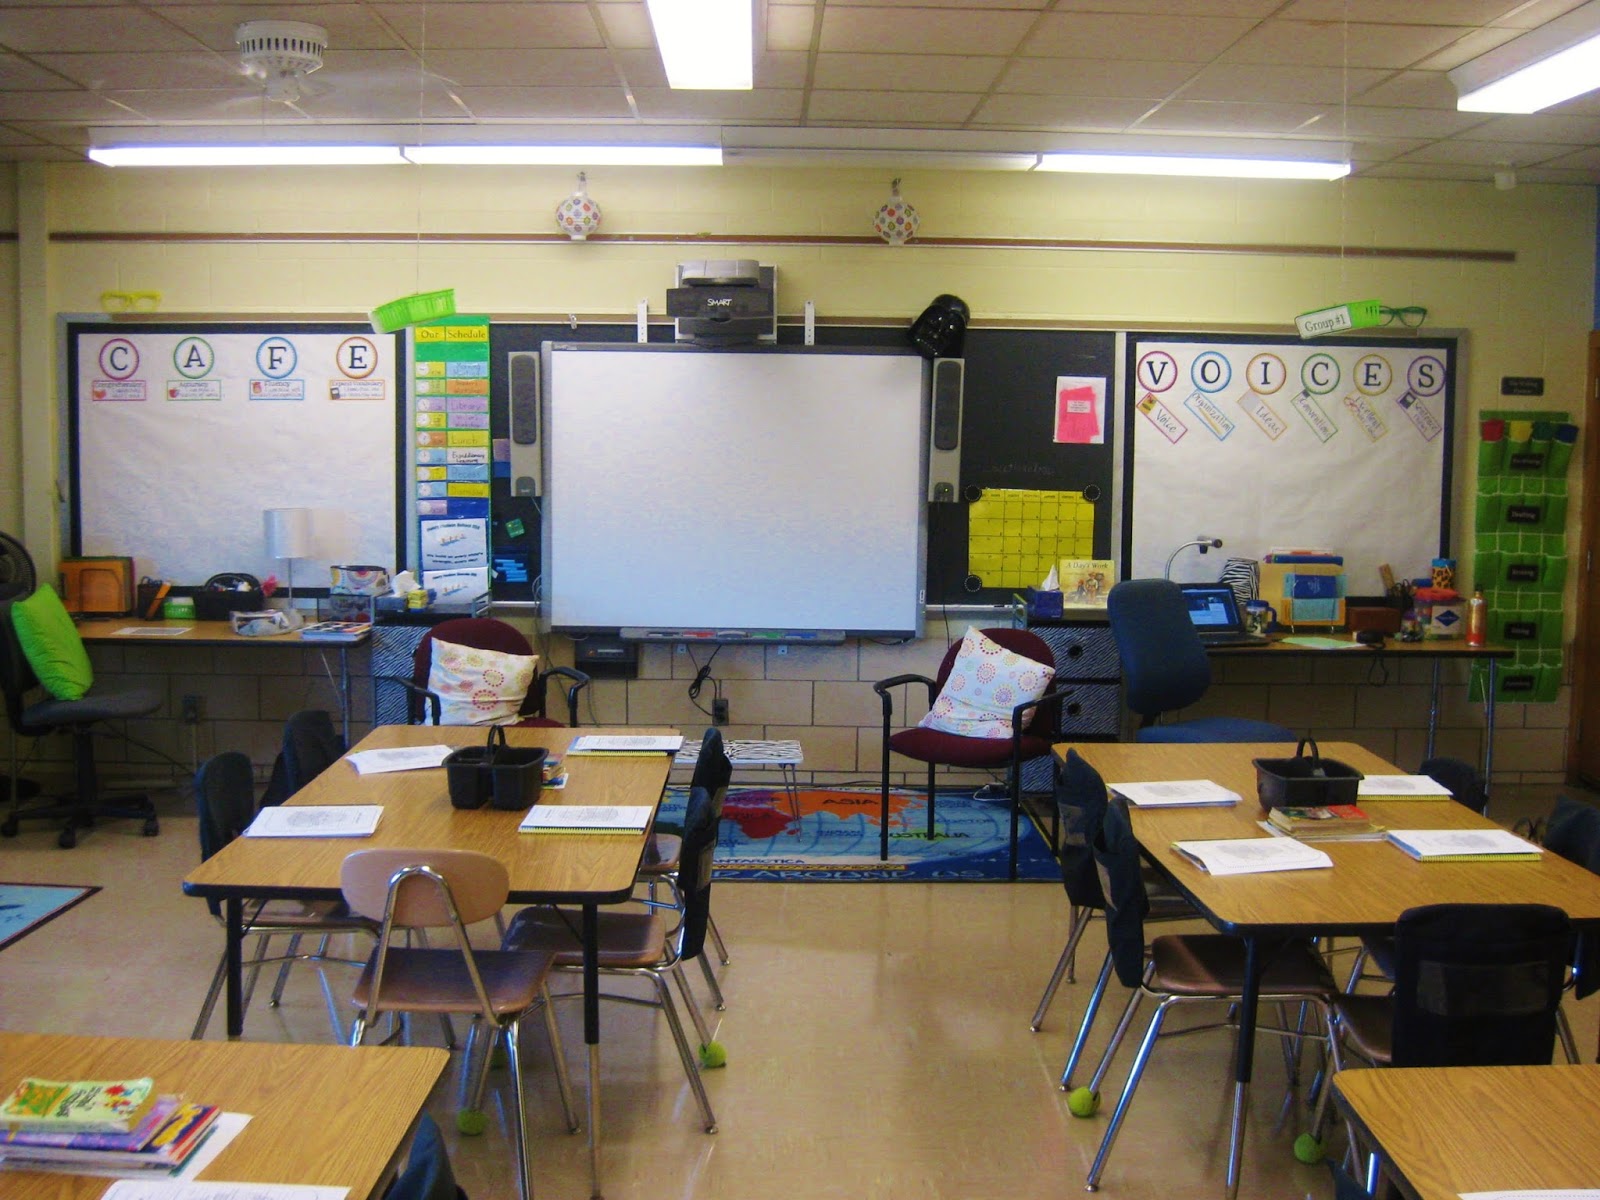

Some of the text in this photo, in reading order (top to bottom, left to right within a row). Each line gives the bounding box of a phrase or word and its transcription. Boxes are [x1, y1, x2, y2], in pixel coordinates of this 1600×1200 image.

[707, 298, 733, 307] SMART
[1304, 314, 1346, 332] Group #1
[420, 329, 486, 339] Our Schedule
[109, 344, 367, 371] C A F E
[1146, 359, 1435, 388] V O I C E S
[450, 402, 481, 411] Library
[1191, 392, 1231, 432] Organization
[1156, 408, 1177, 433] Voice
[1256, 406, 1281, 434] Ideas
[452, 434, 478, 445] Lunch
[1072, 562, 1090, 570] Day's
[753, 869, 916, 878] AROUND
